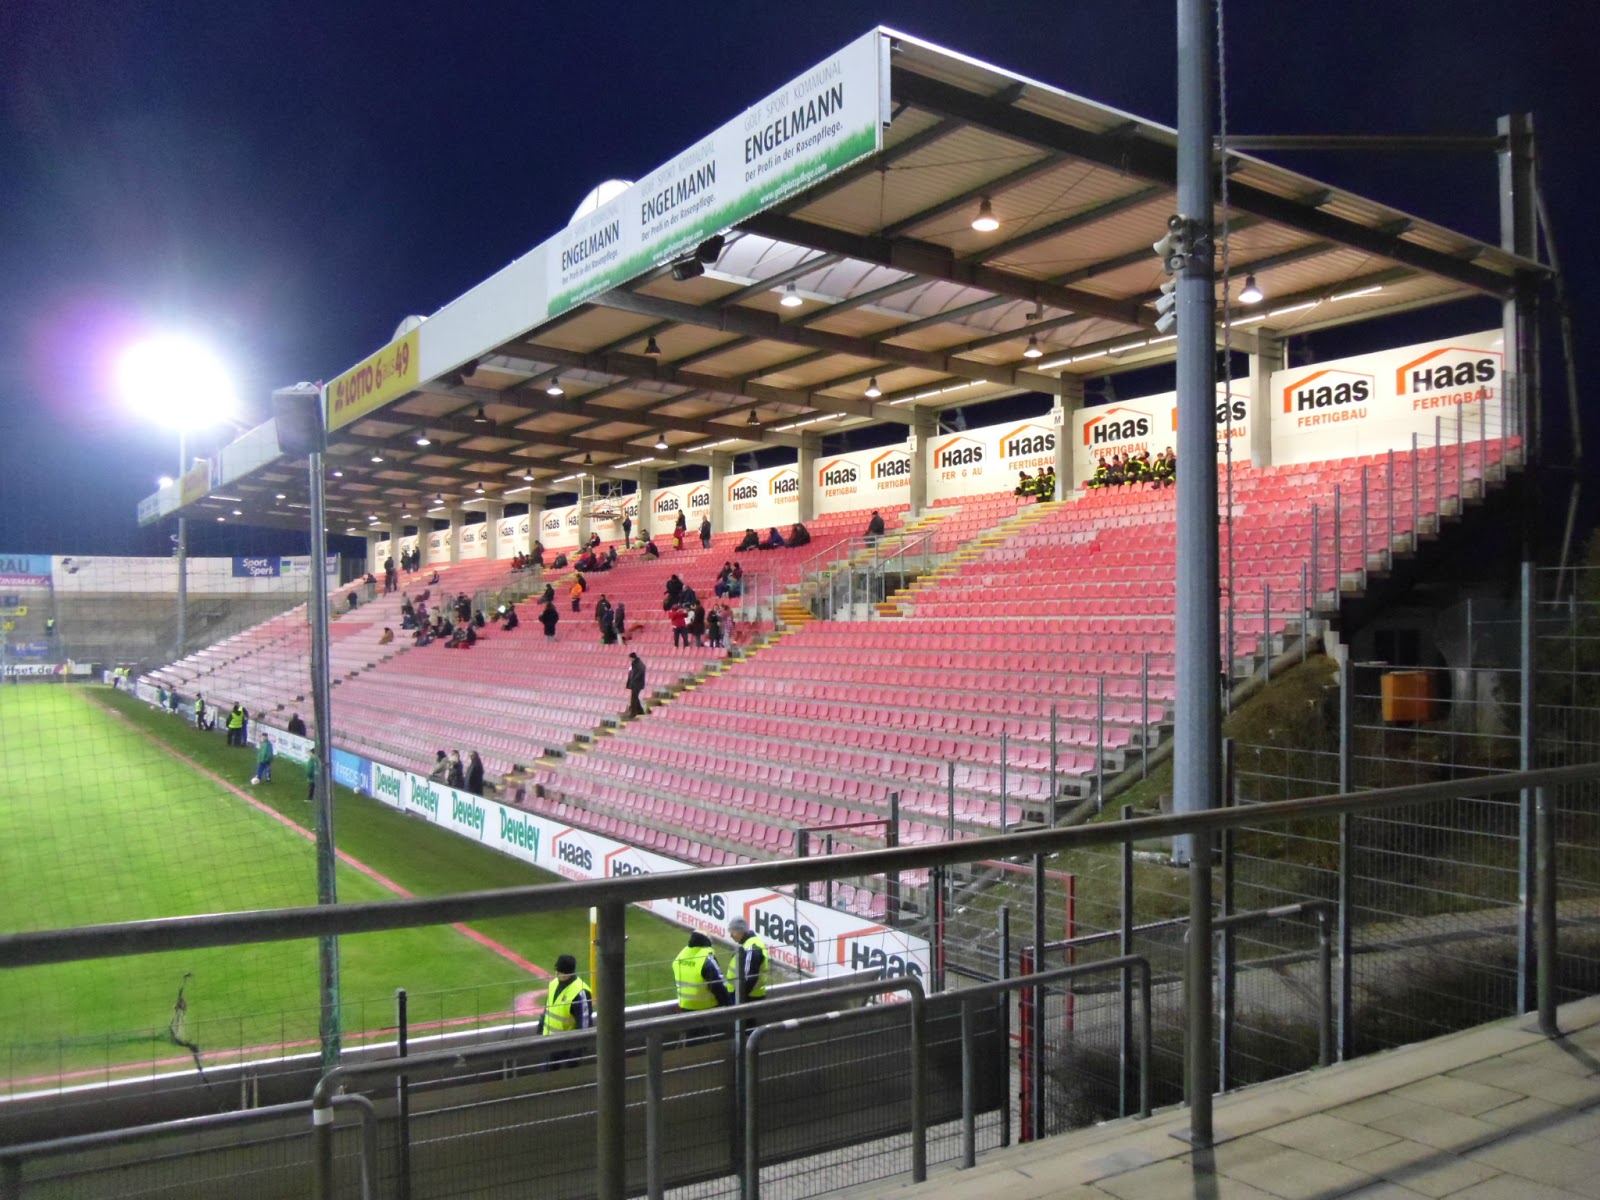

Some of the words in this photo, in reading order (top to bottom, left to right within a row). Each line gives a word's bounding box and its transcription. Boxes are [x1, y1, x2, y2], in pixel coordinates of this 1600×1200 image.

[766, 91, 789, 118] SPORT
[793, 60, 841, 99] KOMMUNAL
[745, 82, 843, 164] ENGELMANN
[745, 169, 756, 182] Der
[757, 157, 773, 176] Profi
[774, 154, 781, 166] in
[783, 146, 794, 160] der
[641, 160, 716, 225] ENGELMANN
[562, 219, 619, 271] ENGELMANN
[345, 364, 373, 406] LOTTO
[1412, 358, 1496, 393] Haas
[1297, 380, 1369, 411] Haas
[1413, 388, 1495, 410] FERTIGBAU
[1216, 401, 1247, 424] as
[1297, 408, 1368, 427] FERTIGBAU
[1094, 418, 1149, 444] Haas
[941, 446, 983, 468] Haas
[1008, 433, 1055, 457] Haas
[1094, 442, 1148, 458] FERTIGBAU
[877, 458, 911, 478] Haas
[1009, 456, 1056, 470] FERTIGBAU
[825, 468, 857, 486] Haas
[691, 493, 710, 508] Haa
[733, 485, 758, 501] Haas
[774, 495, 800, 504] FERTIGBA
[825, 486, 858, 498] FERTIGBAU
[624, 505, 638, 517] Haa
[657, 498, 679, 513] Haas
[545, 518, 560, 530] Haas
[243, 558, 268, 569] Sport
[376, 765, 401, 806] Develey
[411, 775, 439, 822] Develey
[451, 790, 485, 840] Develey
[499, 806, 540, 862] Develey
[558, 840, 592, 871] Haas
[612, 859, 651, 877] Ha
[676, 911, 726, 938] FERTIGBAU
[755, 908, 815, 954] Haas
[766, 945, 816, 973] RTIGBAU
